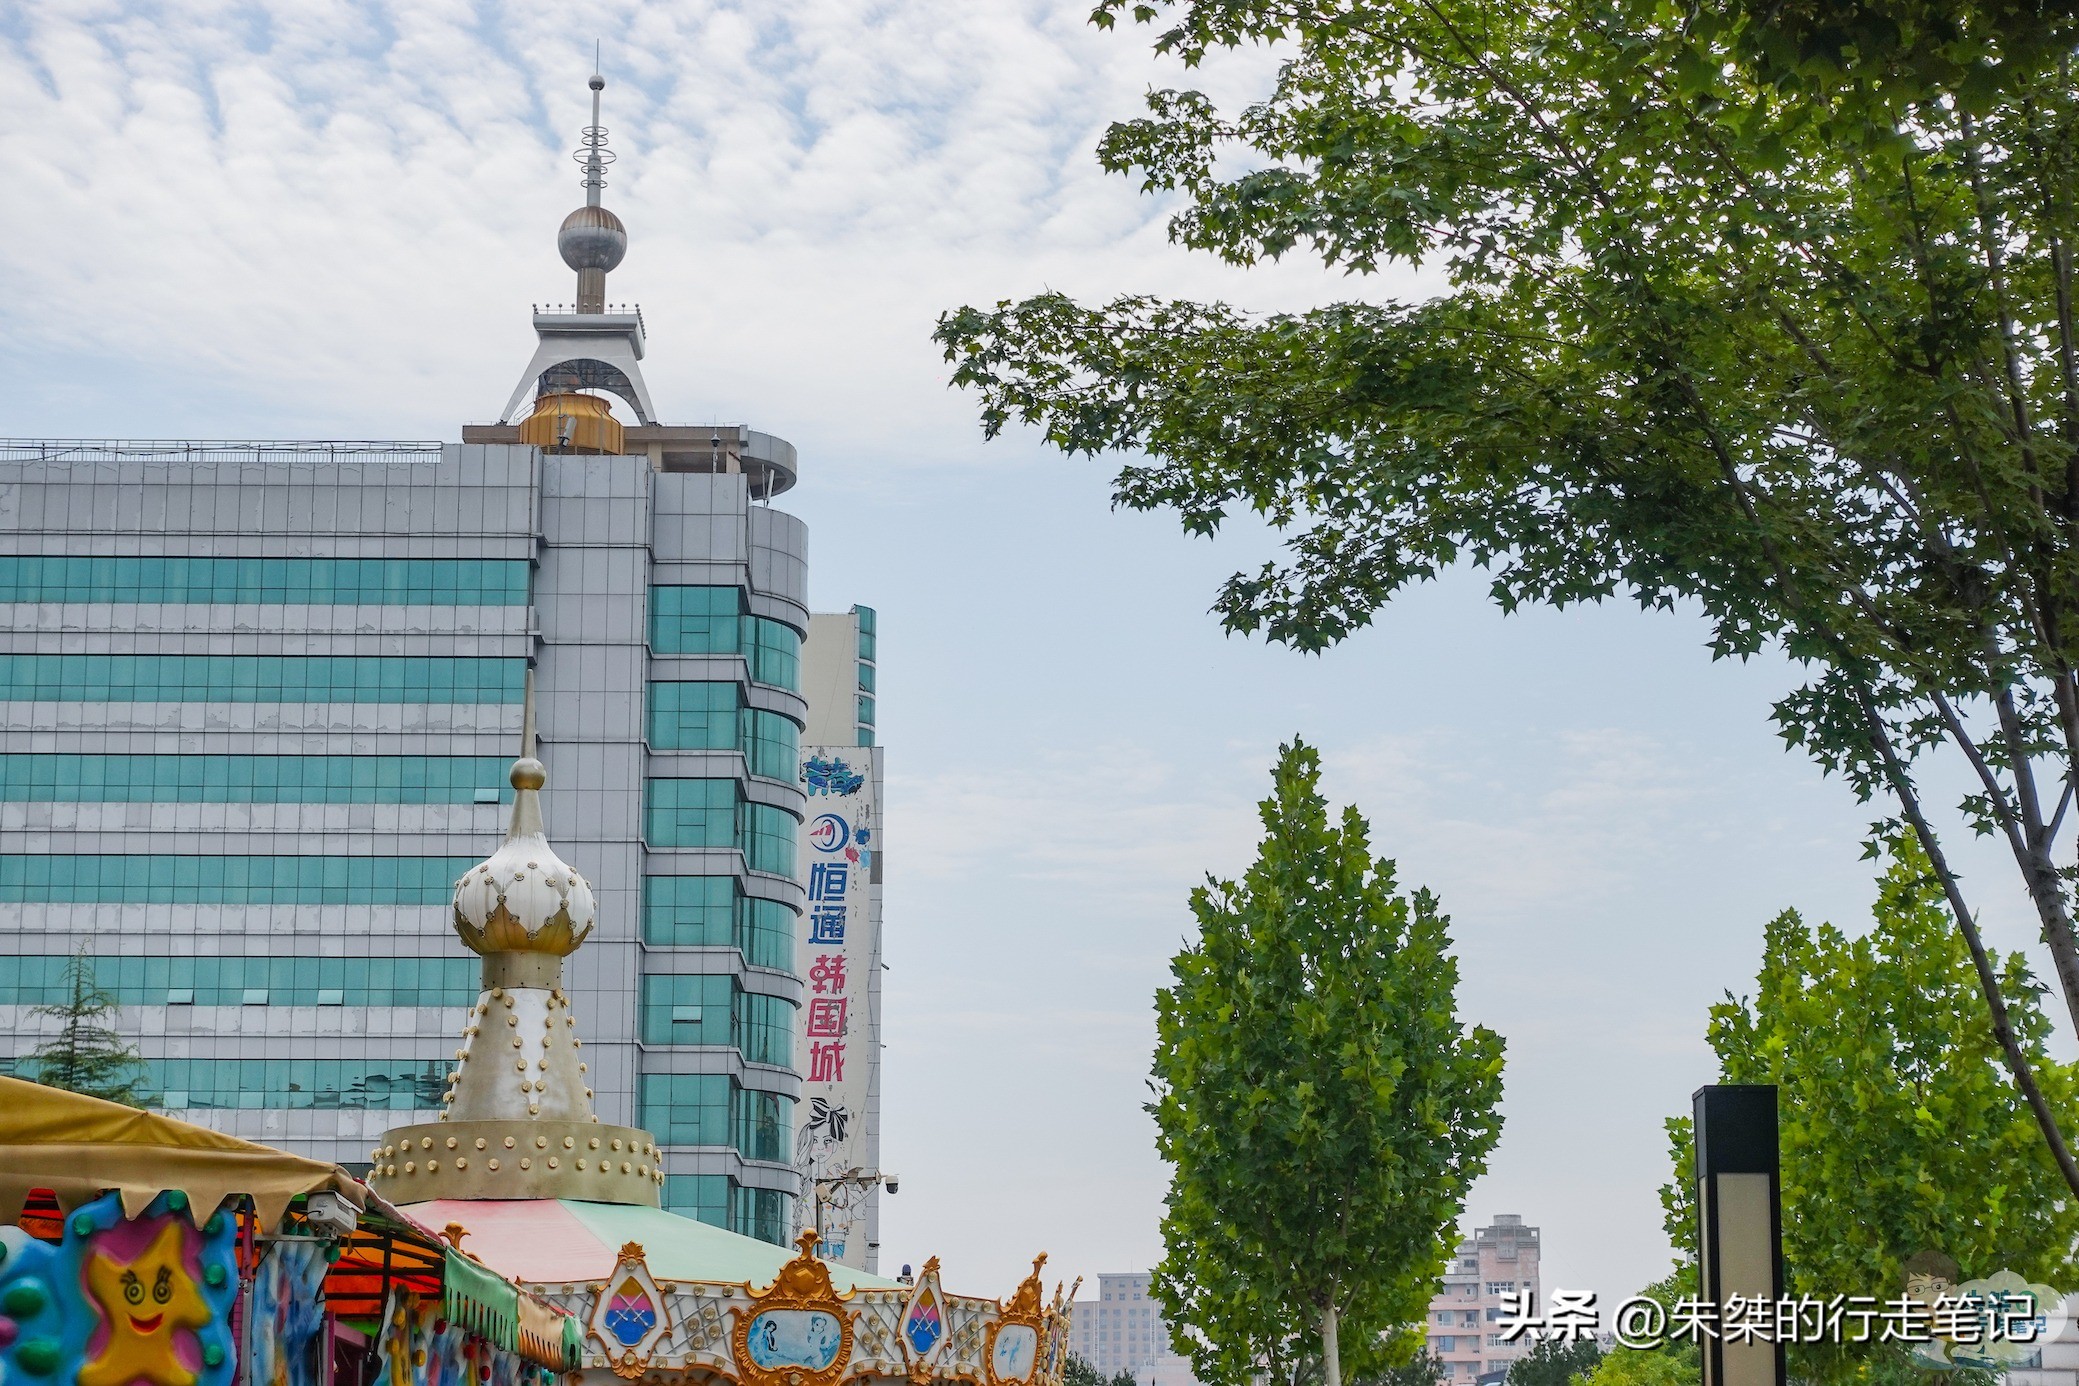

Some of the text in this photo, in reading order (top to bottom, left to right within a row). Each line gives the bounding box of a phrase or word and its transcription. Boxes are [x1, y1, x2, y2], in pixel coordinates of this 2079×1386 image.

[808, 862, 848, 1081] 恒通韩国城
